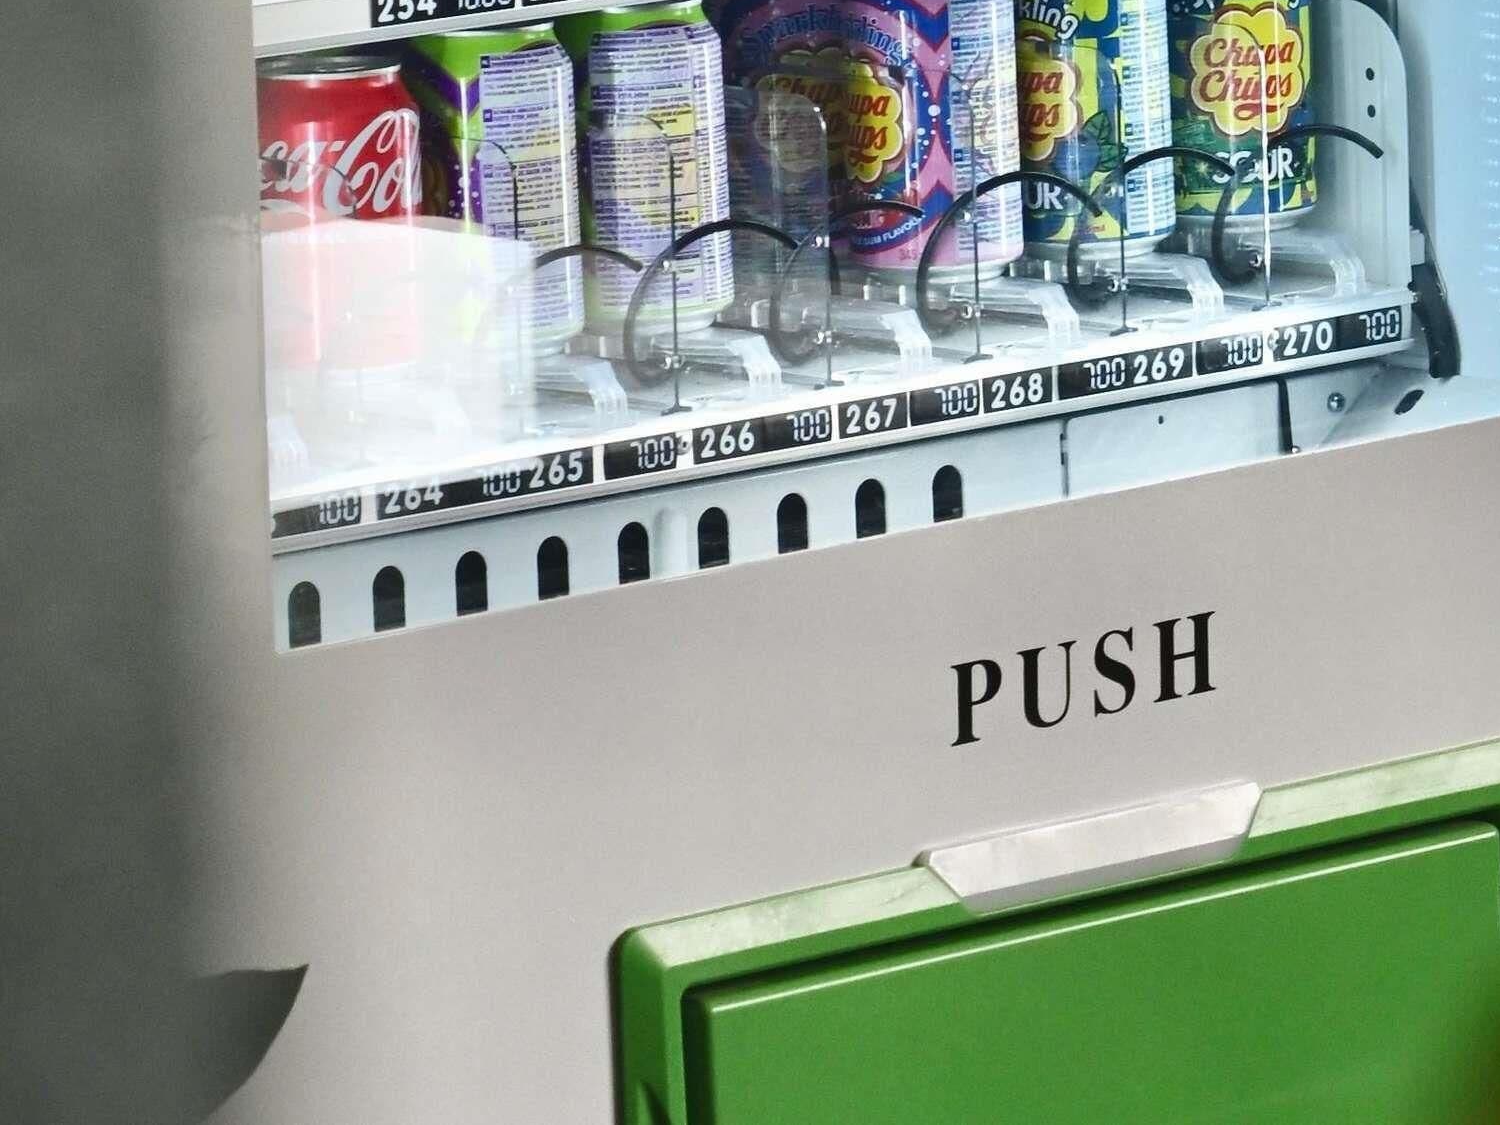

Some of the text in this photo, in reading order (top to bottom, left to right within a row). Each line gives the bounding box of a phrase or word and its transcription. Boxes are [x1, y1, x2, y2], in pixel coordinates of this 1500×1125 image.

[1204, 37, 1295, 67] Chupa
[1200, 71, 1293, 102] Chups
[1283, 321, 1333, 356] 270
[1132, 347, 1185, 384] 269
[991, 372, 1044, 409] 268
[845, 398, 898, 435] 267
[699, 424, 755, 459] 266
[528, 451, 584, 489] 265
[383, 481, 444, 515] 264
[949, 610, 1217, 748] PUSH
